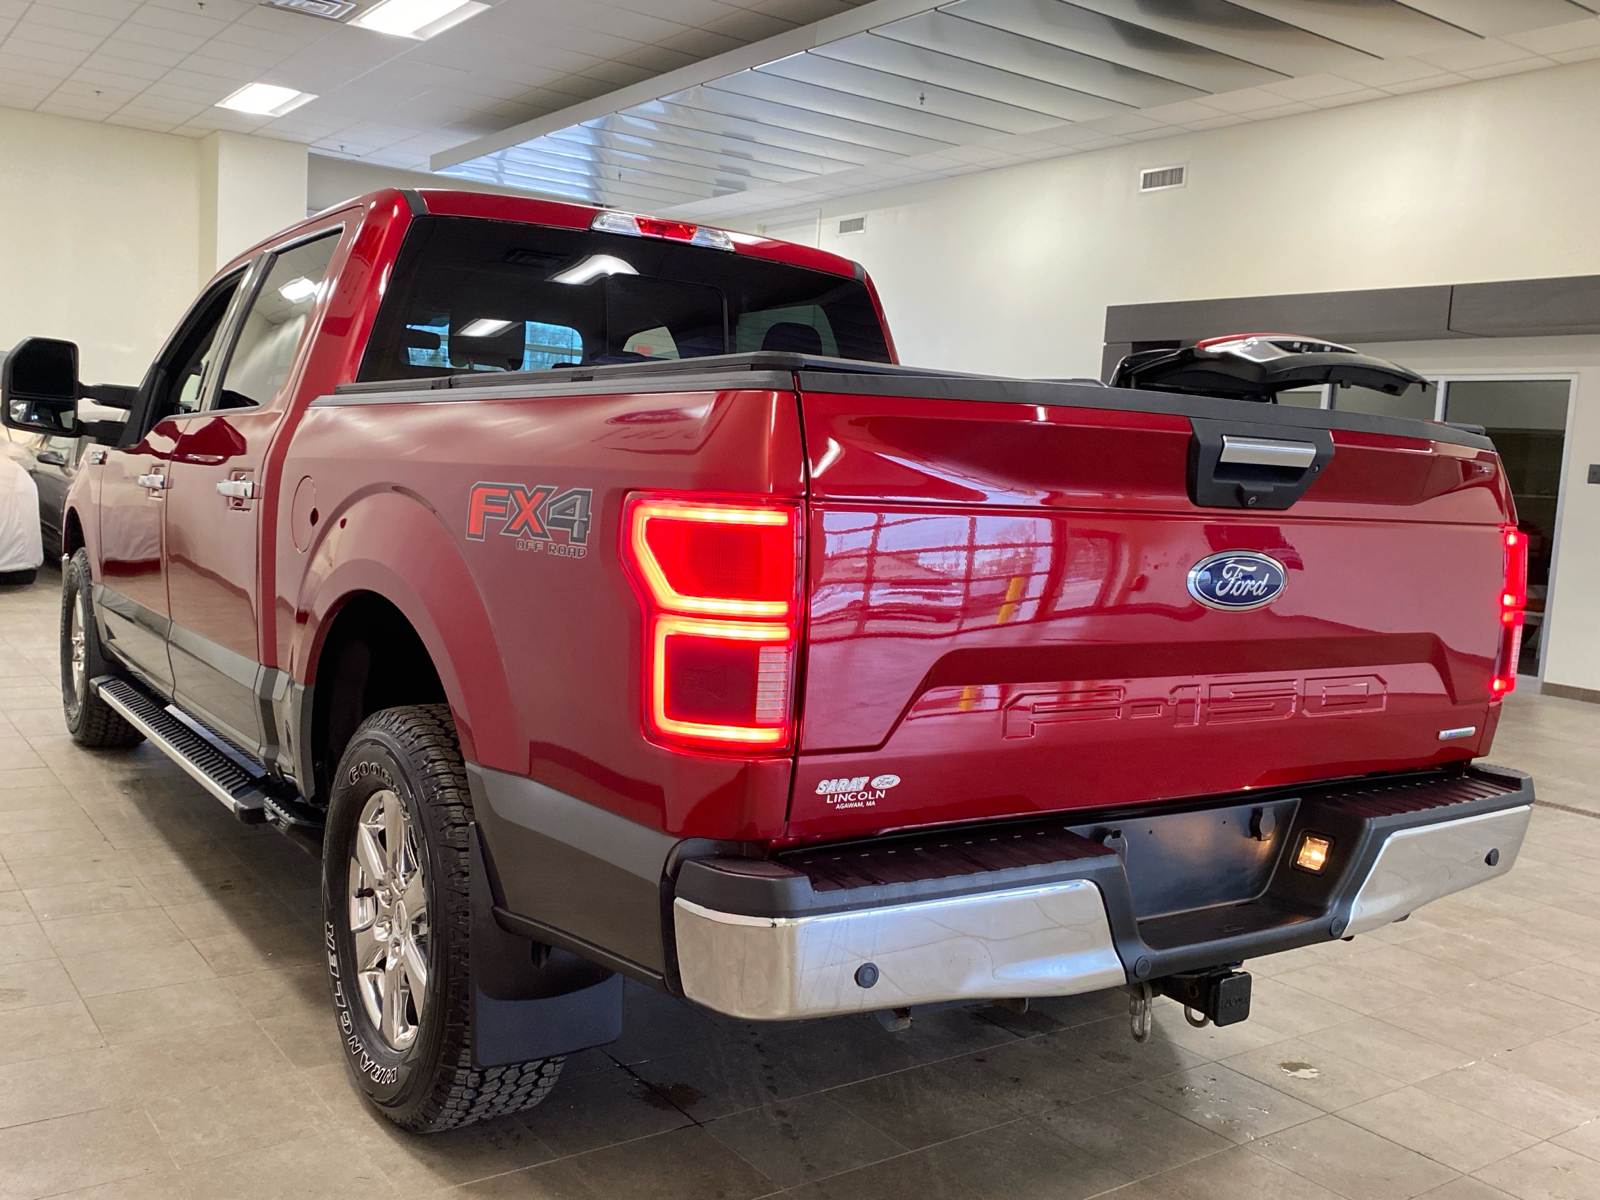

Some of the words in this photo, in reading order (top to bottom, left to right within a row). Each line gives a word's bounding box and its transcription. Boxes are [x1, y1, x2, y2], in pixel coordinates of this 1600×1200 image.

[465, 481, 593, 546] FX4
[516, 539, 544, 552] OFF
[548, 542, 587, 558] ROAD
[1215, 560, 1269, 597] Ford
[1002, 674, 1388, 740] F-150
[816, 776, 870, 794] SARAT
[826, 790, 886, 804] LINCOLN
[835, 801, 865, 809] AGAWAM,
[325, 921, 397, 1084] WRANGLER
